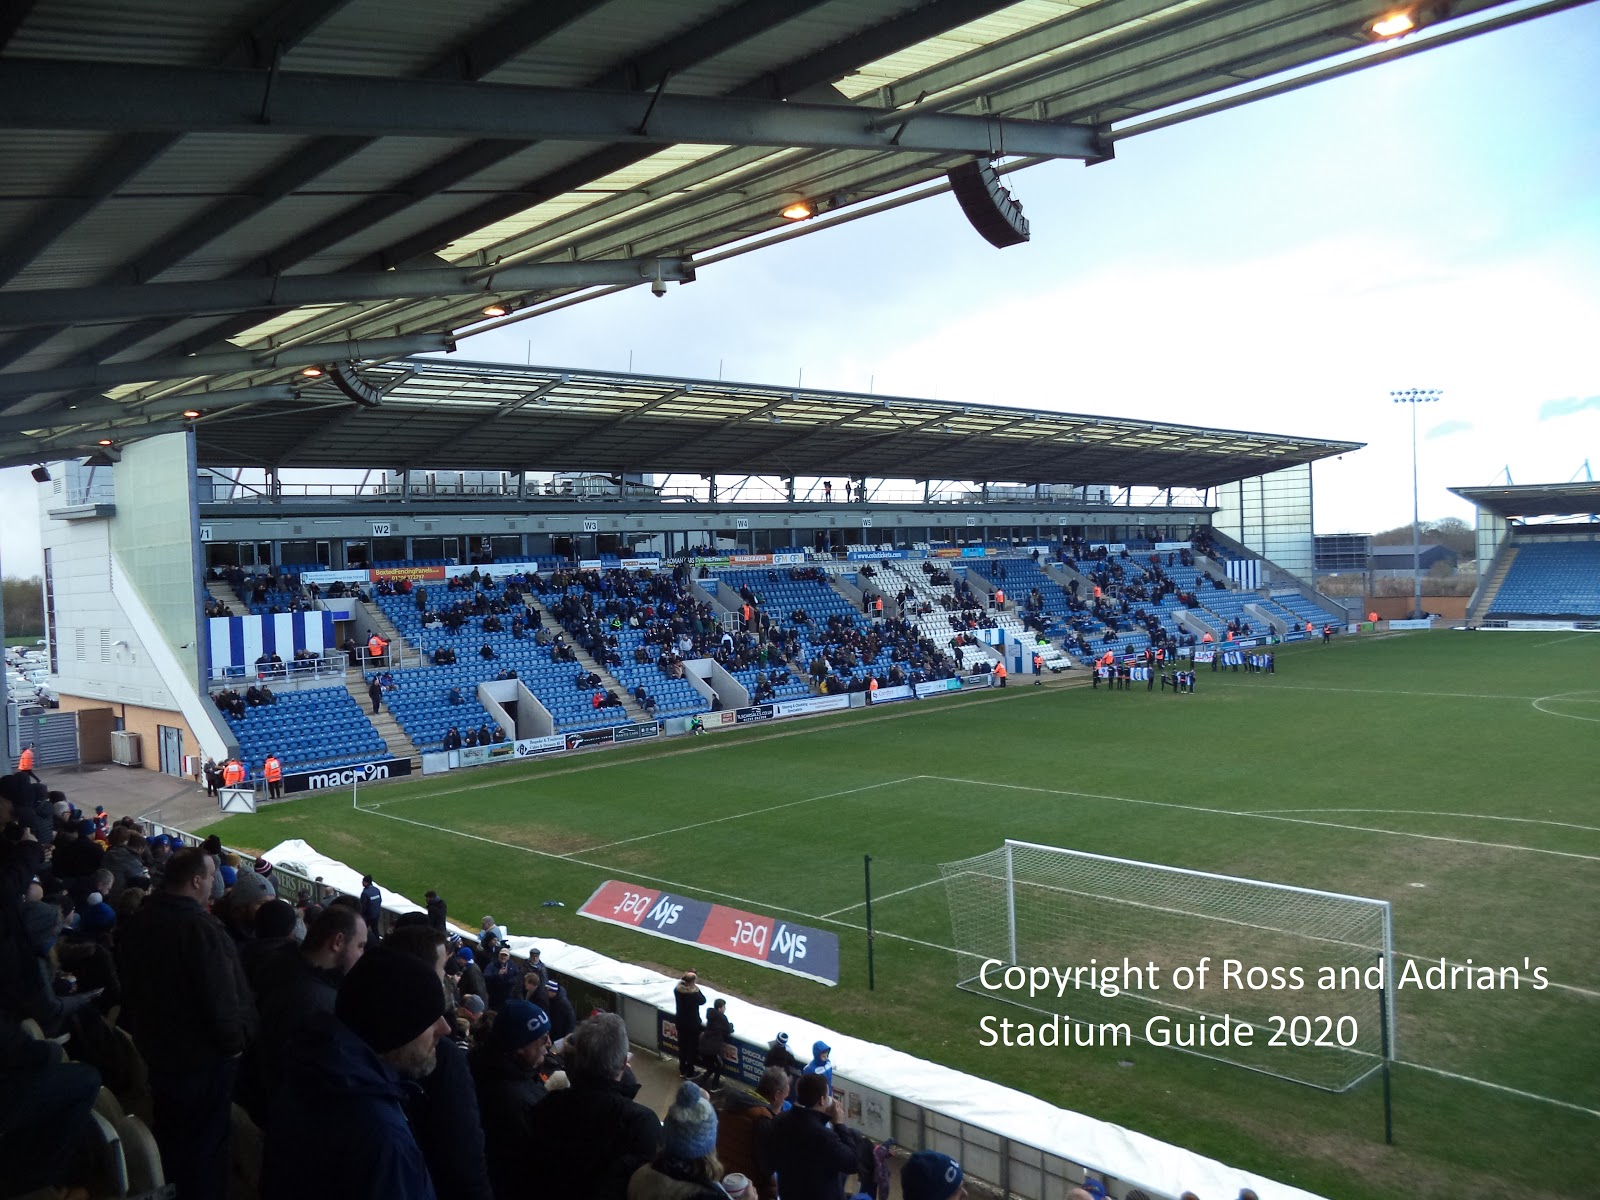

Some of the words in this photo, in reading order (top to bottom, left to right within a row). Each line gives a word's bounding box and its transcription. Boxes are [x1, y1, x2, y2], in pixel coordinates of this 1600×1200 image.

[374, 525, 389, 534] W2
[584, 522, 597, 530] W3
[614, 891, 651, 922] bet
[646, 895, 683, 929] sky
[730, 920, 768, 955] bet
[771, 924, 808, 964] sky
